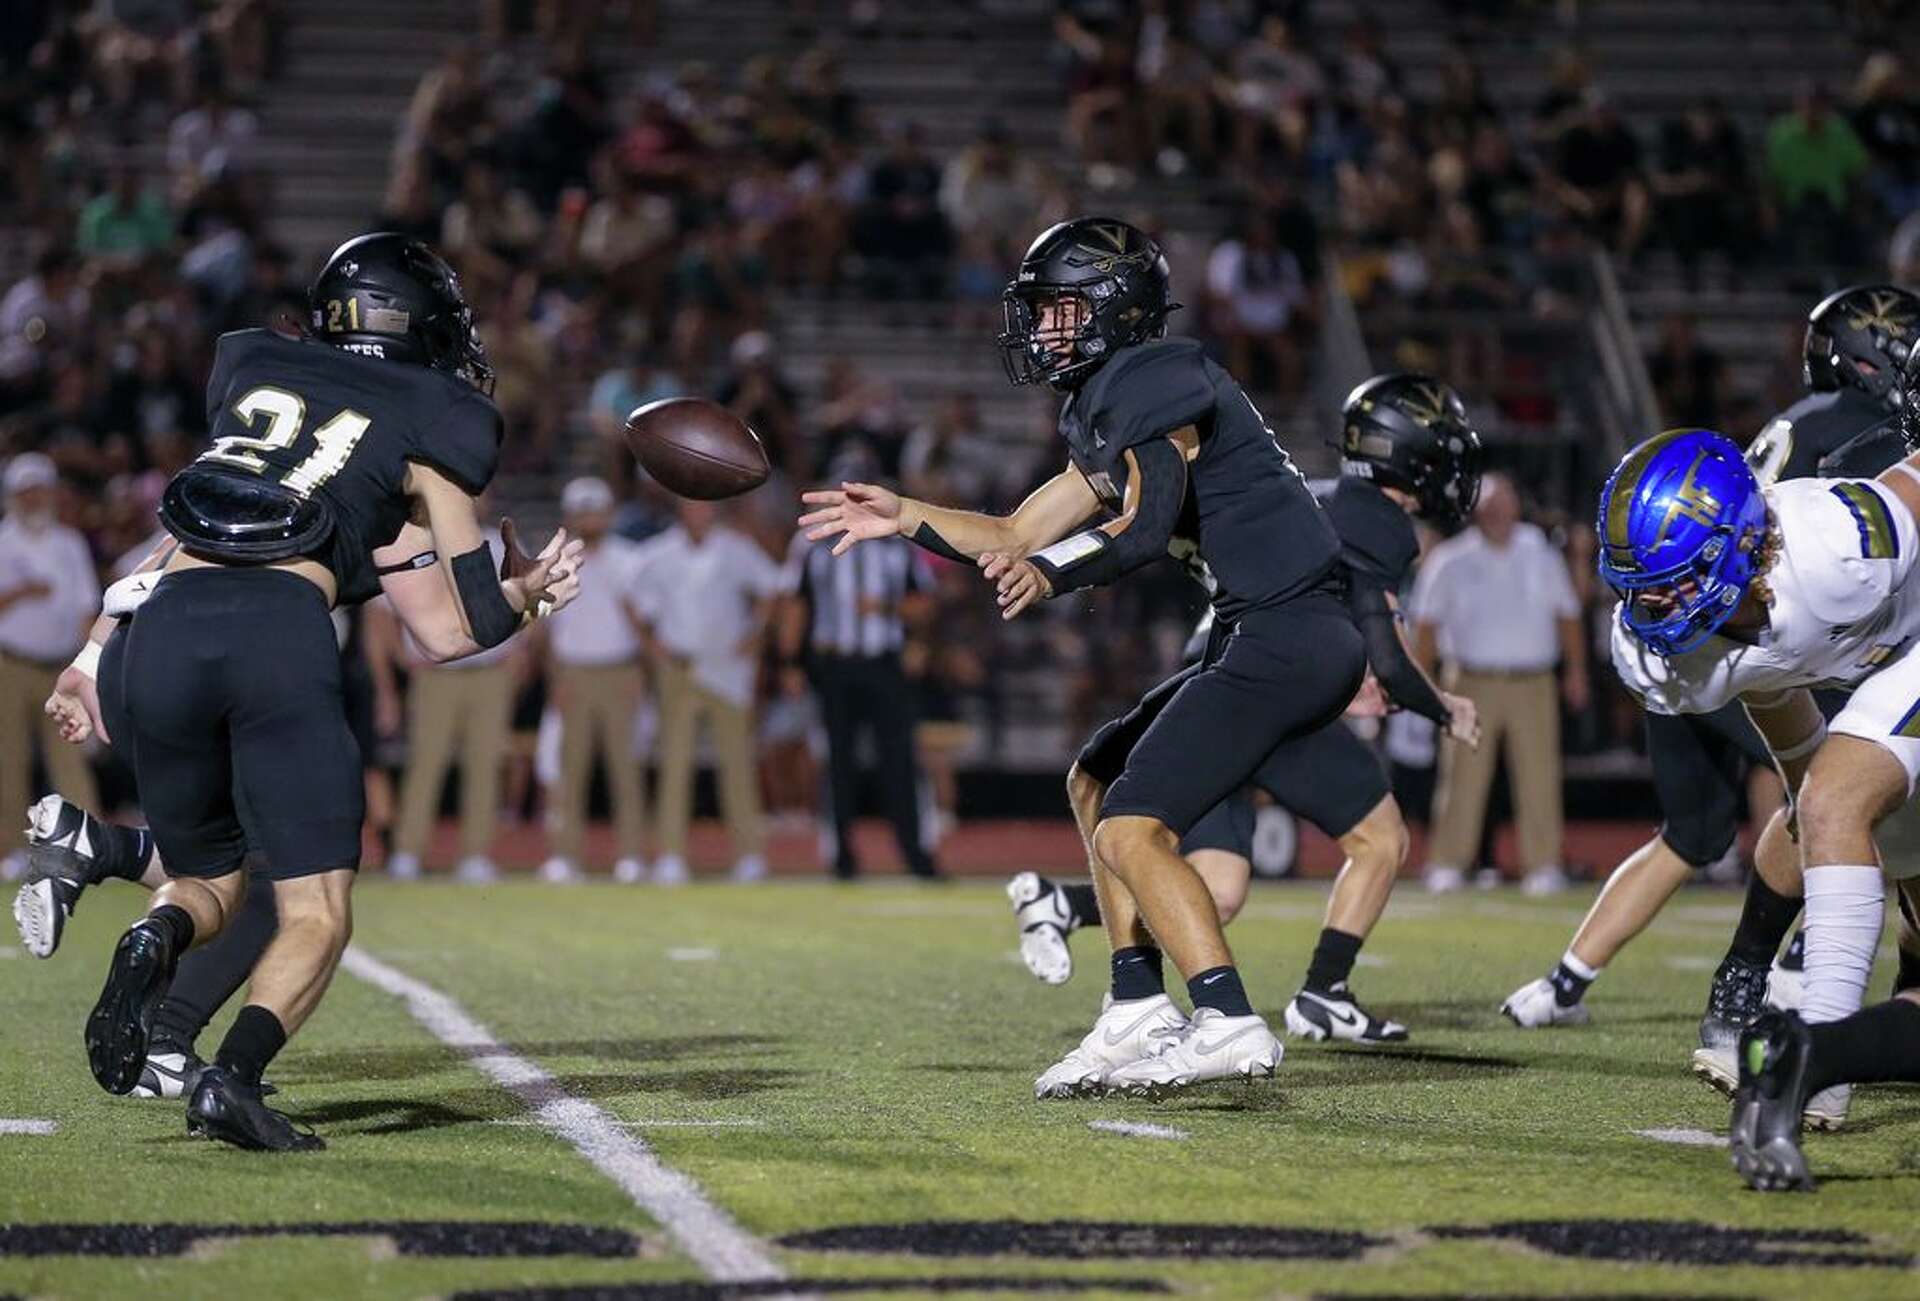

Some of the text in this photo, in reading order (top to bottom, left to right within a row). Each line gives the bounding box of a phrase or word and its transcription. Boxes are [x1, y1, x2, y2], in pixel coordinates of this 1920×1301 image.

[327, 297, 359, 332] 21
[343, 343, 385, 359] TES
[195, 384, 372, 500] 21
[1347, 425, 1360, 451] 3
